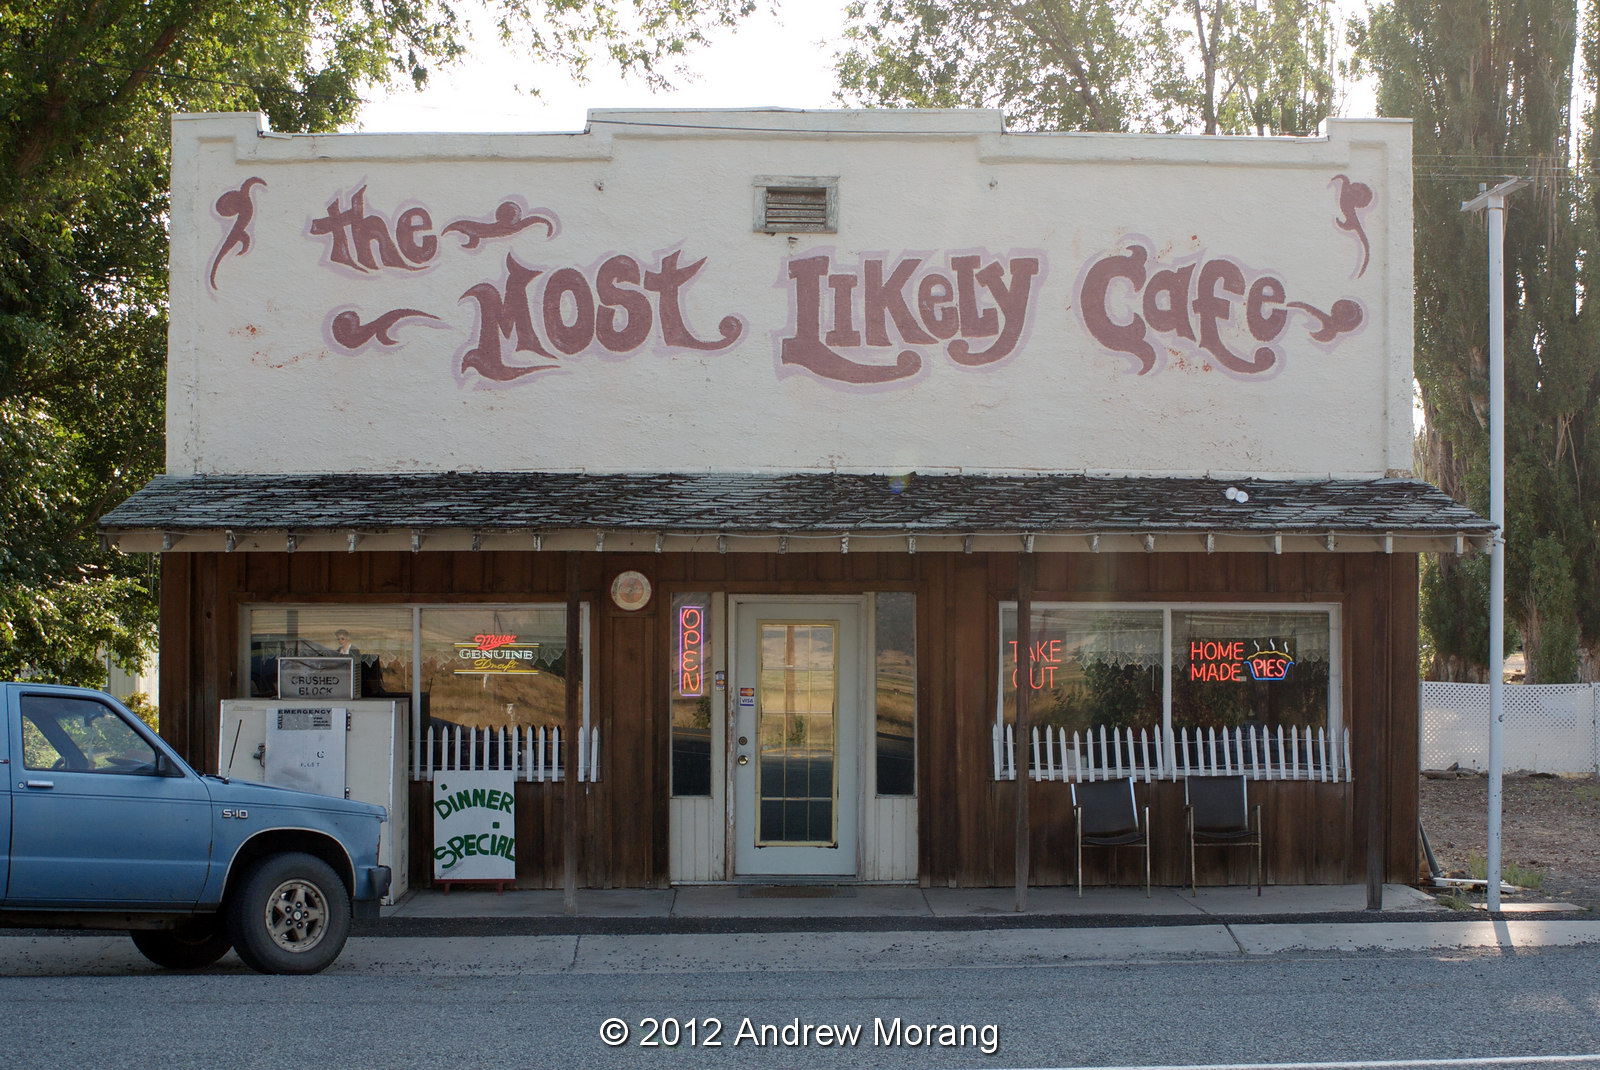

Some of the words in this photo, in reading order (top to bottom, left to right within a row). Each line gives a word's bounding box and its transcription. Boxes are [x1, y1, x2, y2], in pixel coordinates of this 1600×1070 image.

[310, 184, 437, 274] the
[1080, 244, 1287, 376] Cafe
[474, 634, 517, 650] Miller
[682, 609, 701, 692] OPEN
[1190, 641, 1244, 661] HOME
[459, 649, 534, 660] GENUINE
[474, 659, 519, 673] Draft
[1190, 662, 1242, 682] MADE
[1252, 659, 1287, 677] PIES
[291, 676, 339, 686] CRUSHED
